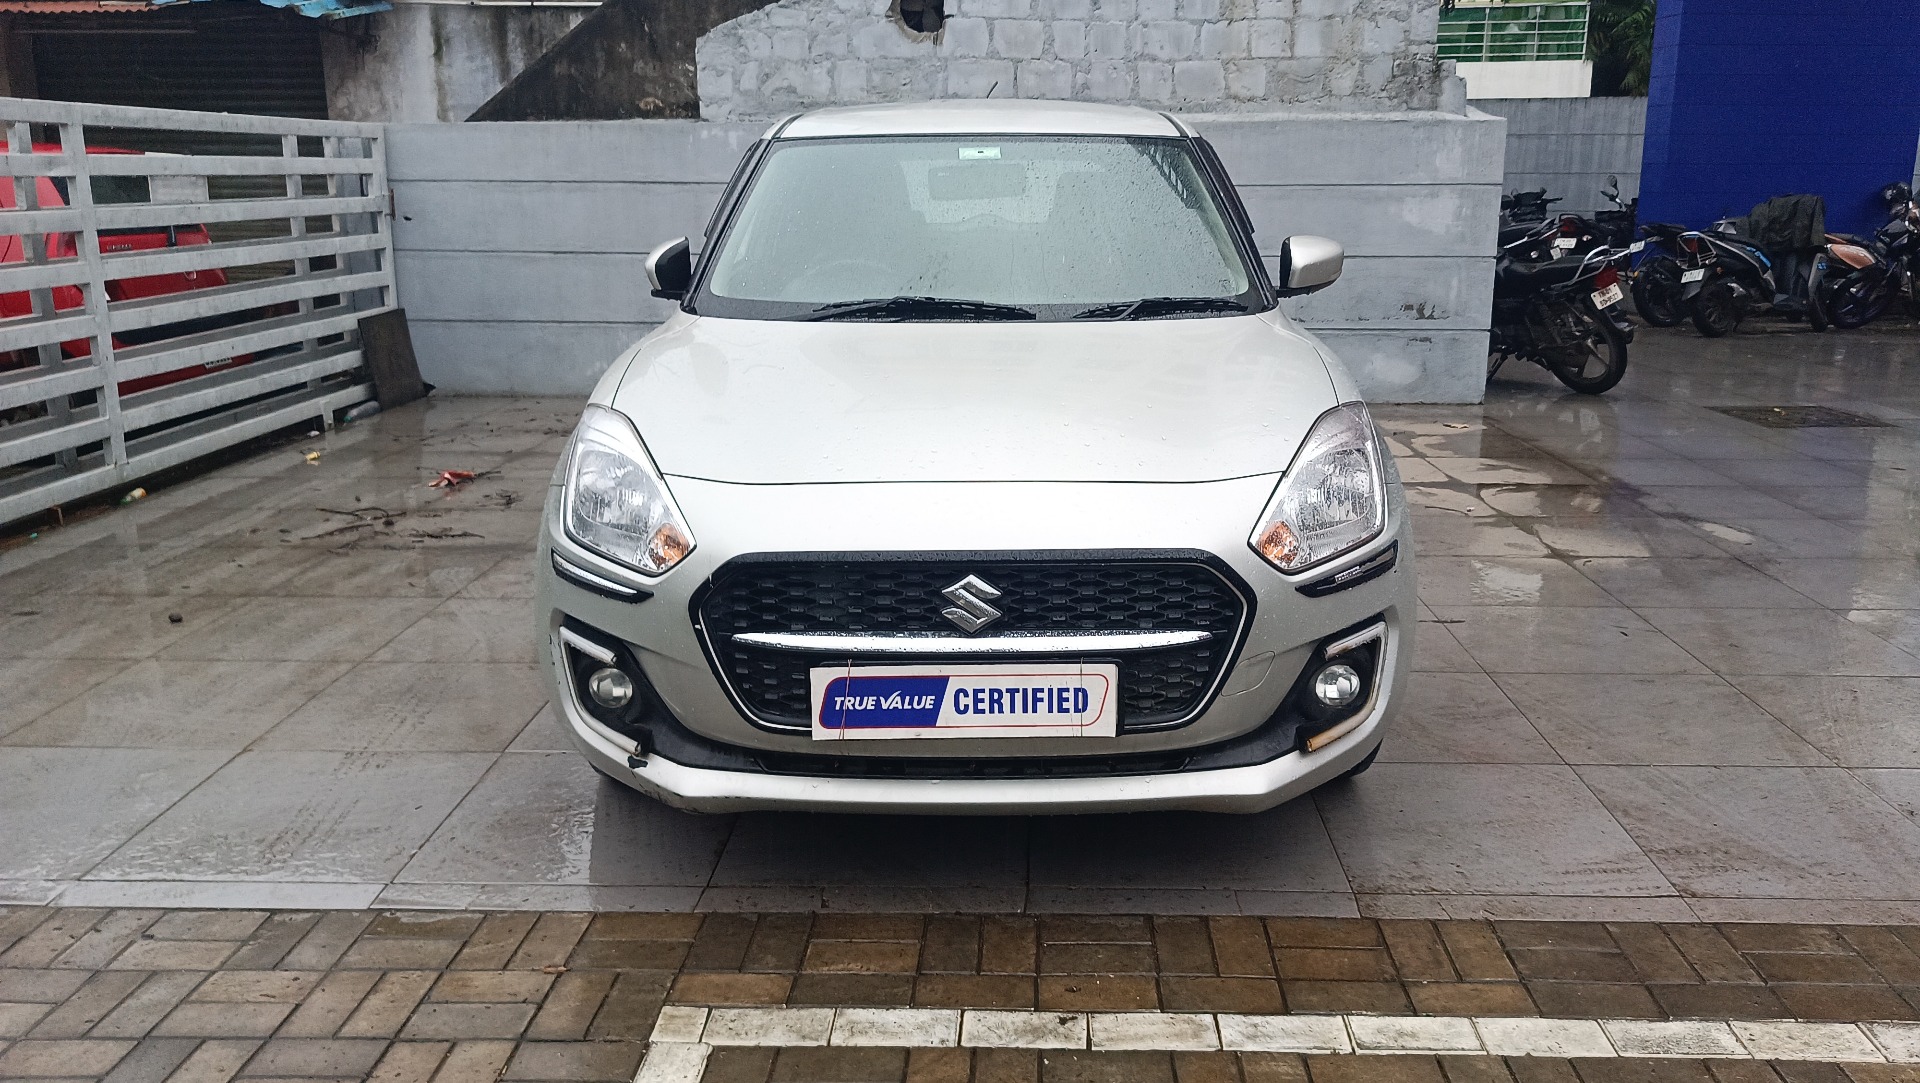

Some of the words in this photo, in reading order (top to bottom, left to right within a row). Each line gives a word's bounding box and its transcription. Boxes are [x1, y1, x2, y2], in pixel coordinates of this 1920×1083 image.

[834, 696, 877, 711] TRUE
[879, 690, 936, 710] VALUE
[953, 687, 1089, 716] CERTIFIED
